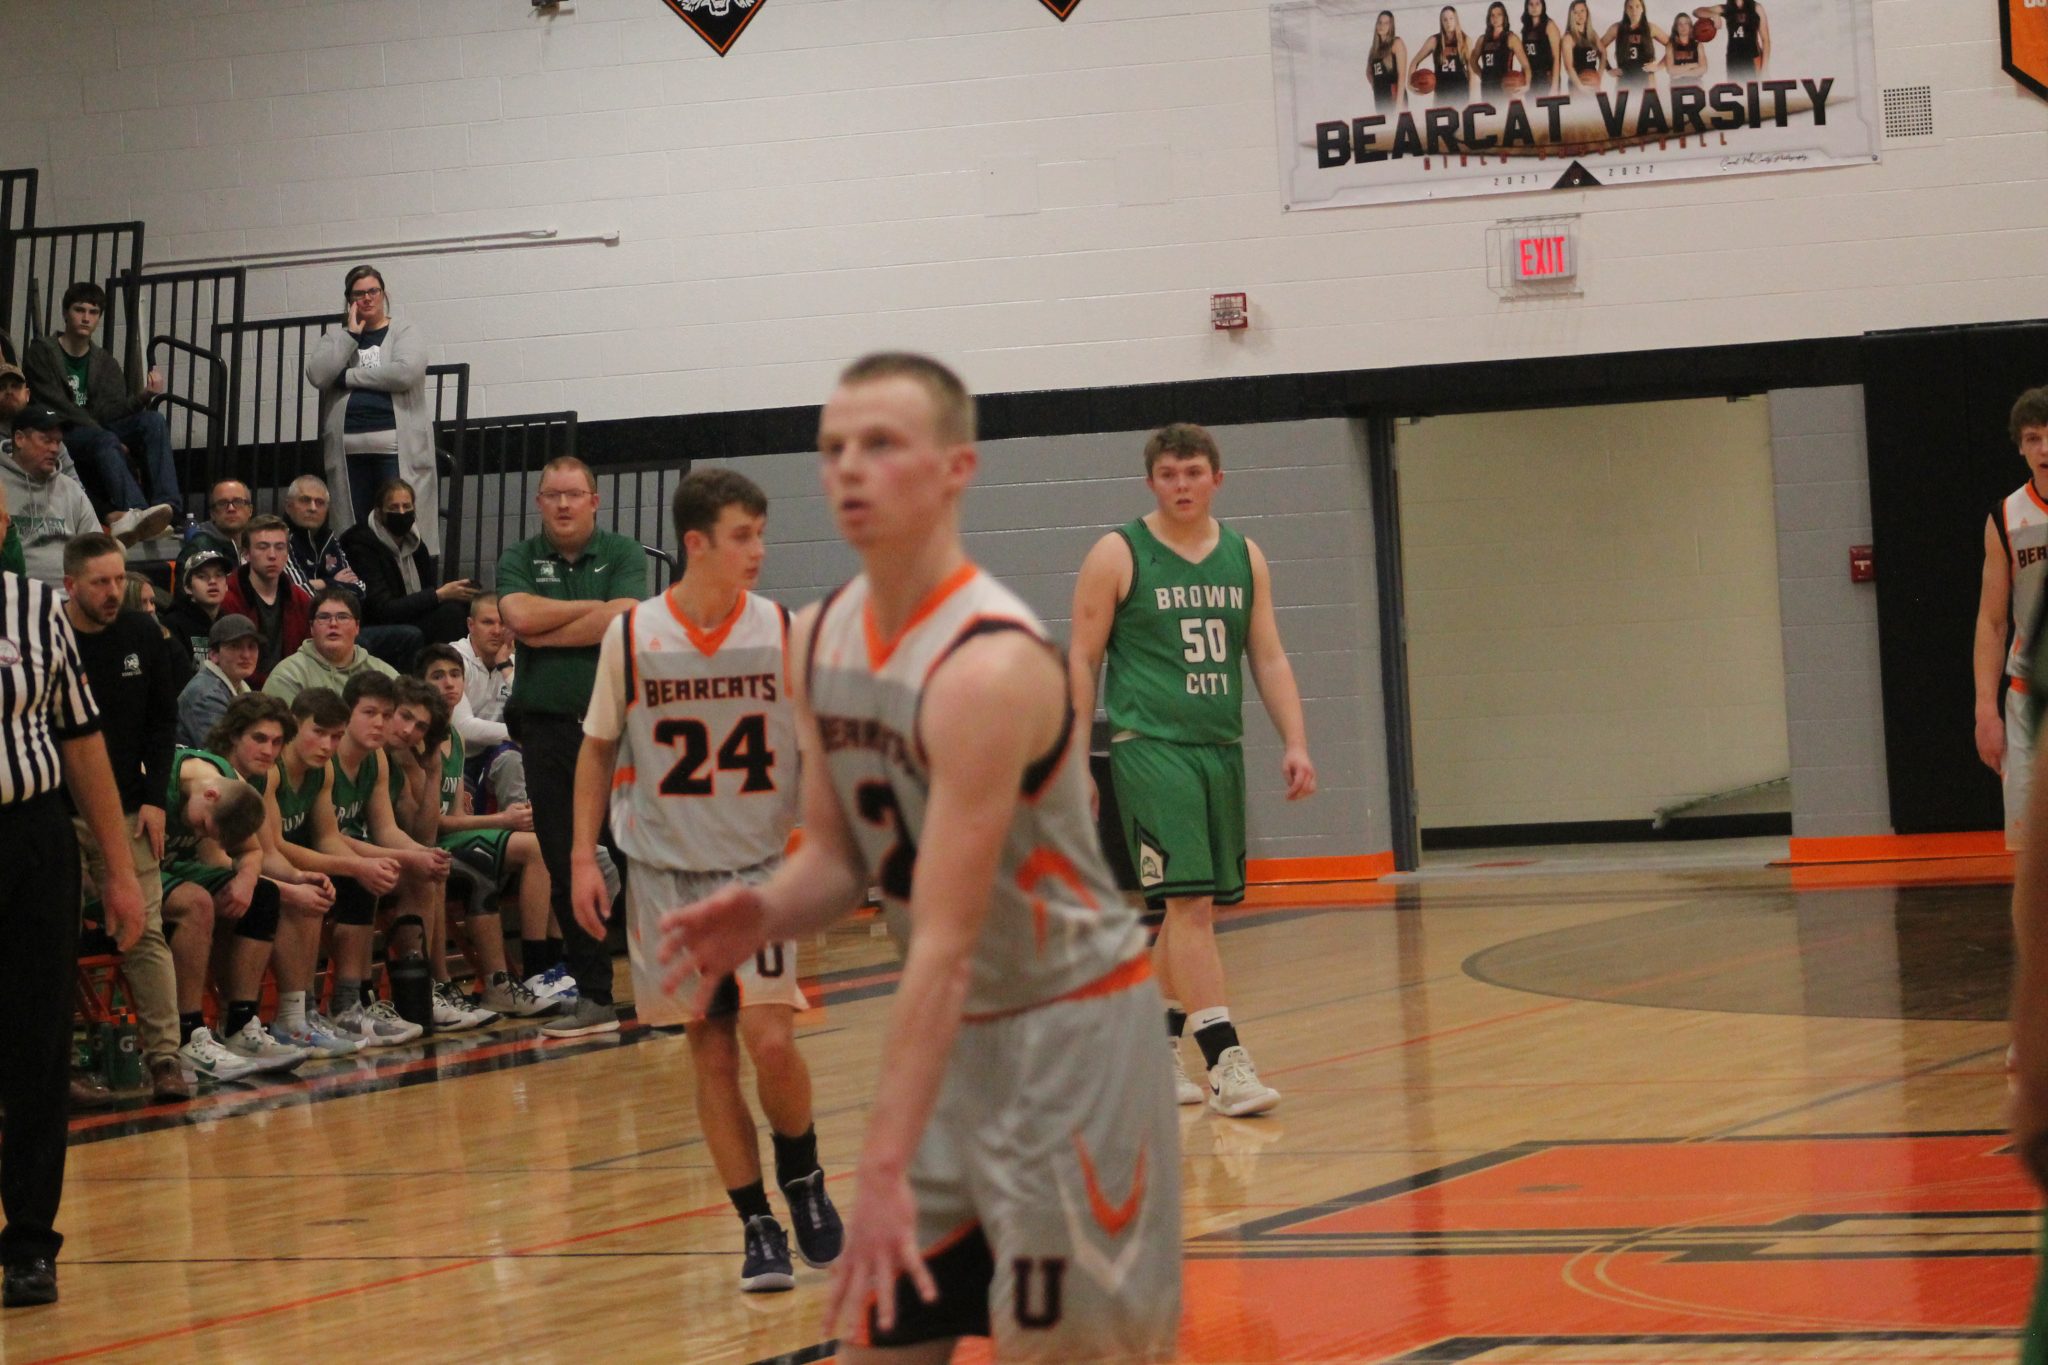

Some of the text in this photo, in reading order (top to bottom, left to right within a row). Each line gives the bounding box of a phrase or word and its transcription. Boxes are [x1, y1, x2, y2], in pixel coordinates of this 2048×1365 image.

[1441, 59, 1456, 72] 24
[1586, 50, 1597, 62] 22
[1629, 47, 1638, 59] 3
[1316, 77, 1835, 169] BEARCAT VARSITY
[1520, 236, 1565, 276] EXIT
[1154, 585, 1243, 610] BROWN
[1180, 617, 1227, 663] 50
[644, 673, 777, 708] BEARCATS
[1186, 672, 1228, 695] CITY
[653, 712, 778, 798] 24
[756, 942, 784, 978] U
[1012, 1255, 1067, 1330] U
